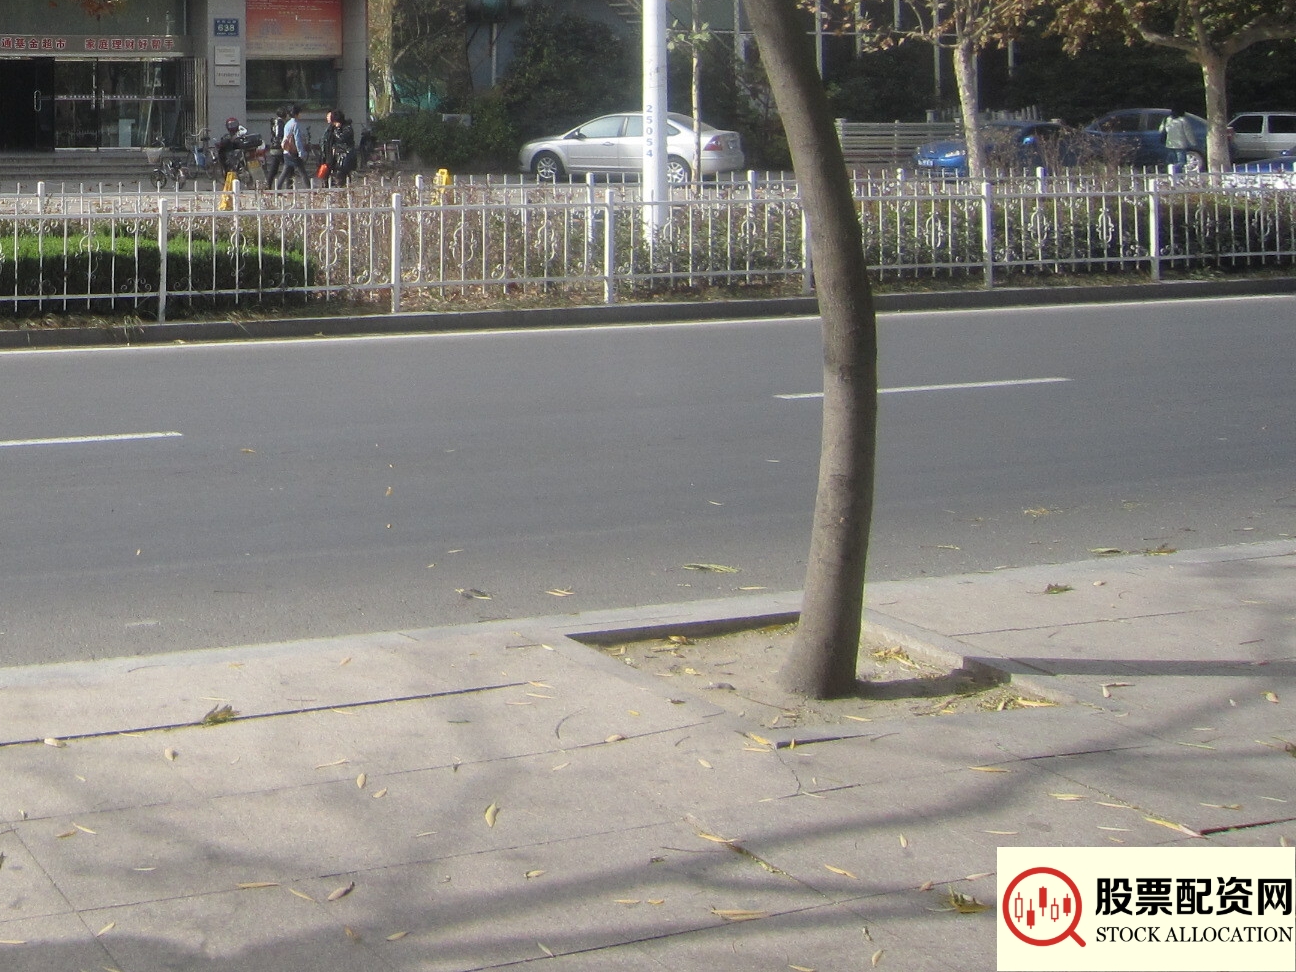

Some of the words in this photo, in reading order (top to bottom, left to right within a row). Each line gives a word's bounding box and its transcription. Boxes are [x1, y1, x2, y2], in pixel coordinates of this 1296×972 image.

[85, 38, 174, 50] 家庭理财好帮手
[646, 104, 654, 158] 25054
